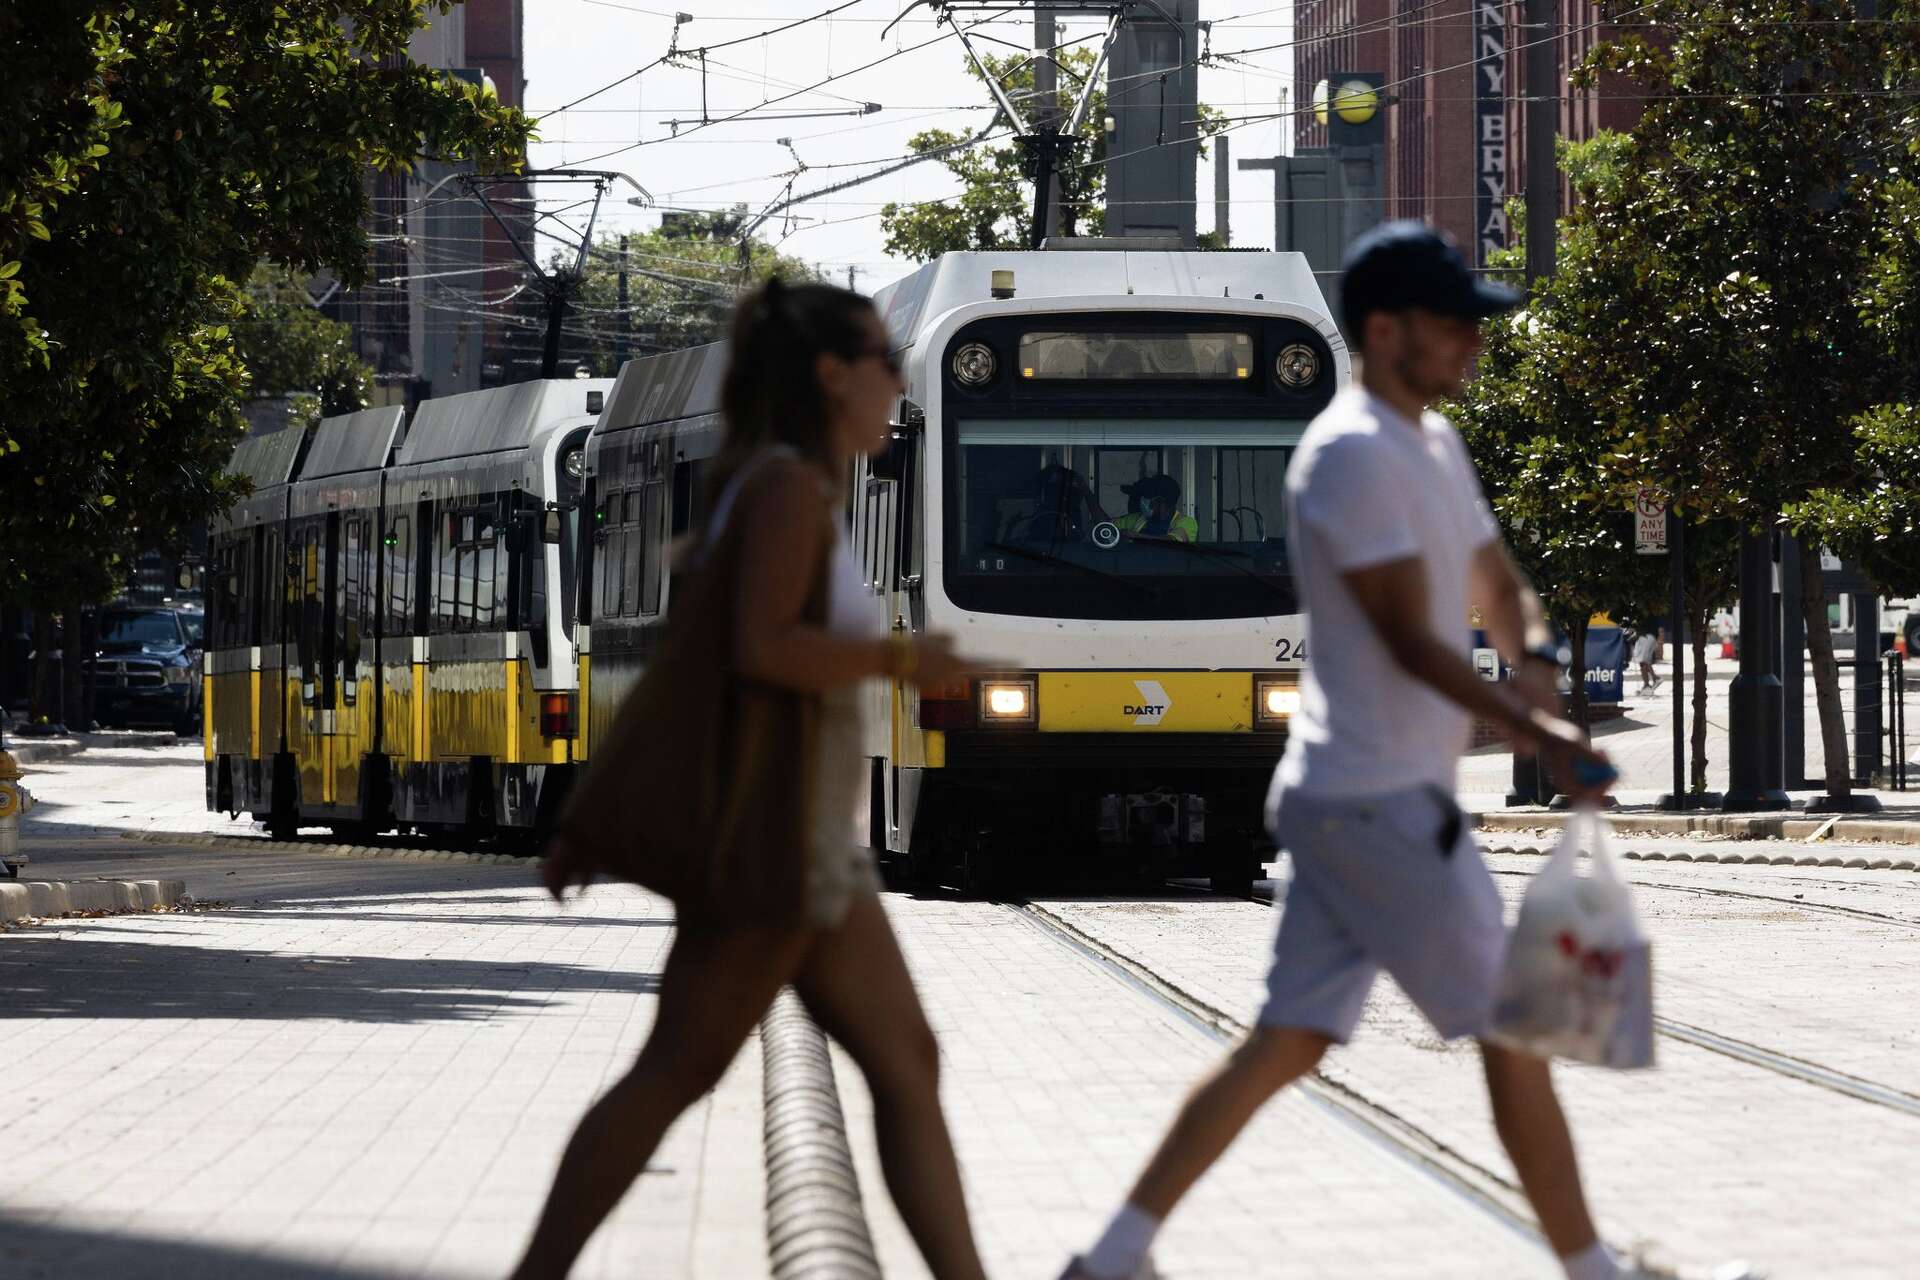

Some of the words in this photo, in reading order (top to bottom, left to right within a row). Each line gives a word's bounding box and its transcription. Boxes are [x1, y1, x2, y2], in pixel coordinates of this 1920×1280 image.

[1640, 520, 1663, 529] ANY
[1640, 530, 1665, 541] TIME
[1566, 667, 1616, 683] nter
[1123, 705, 1164, 716] DART
